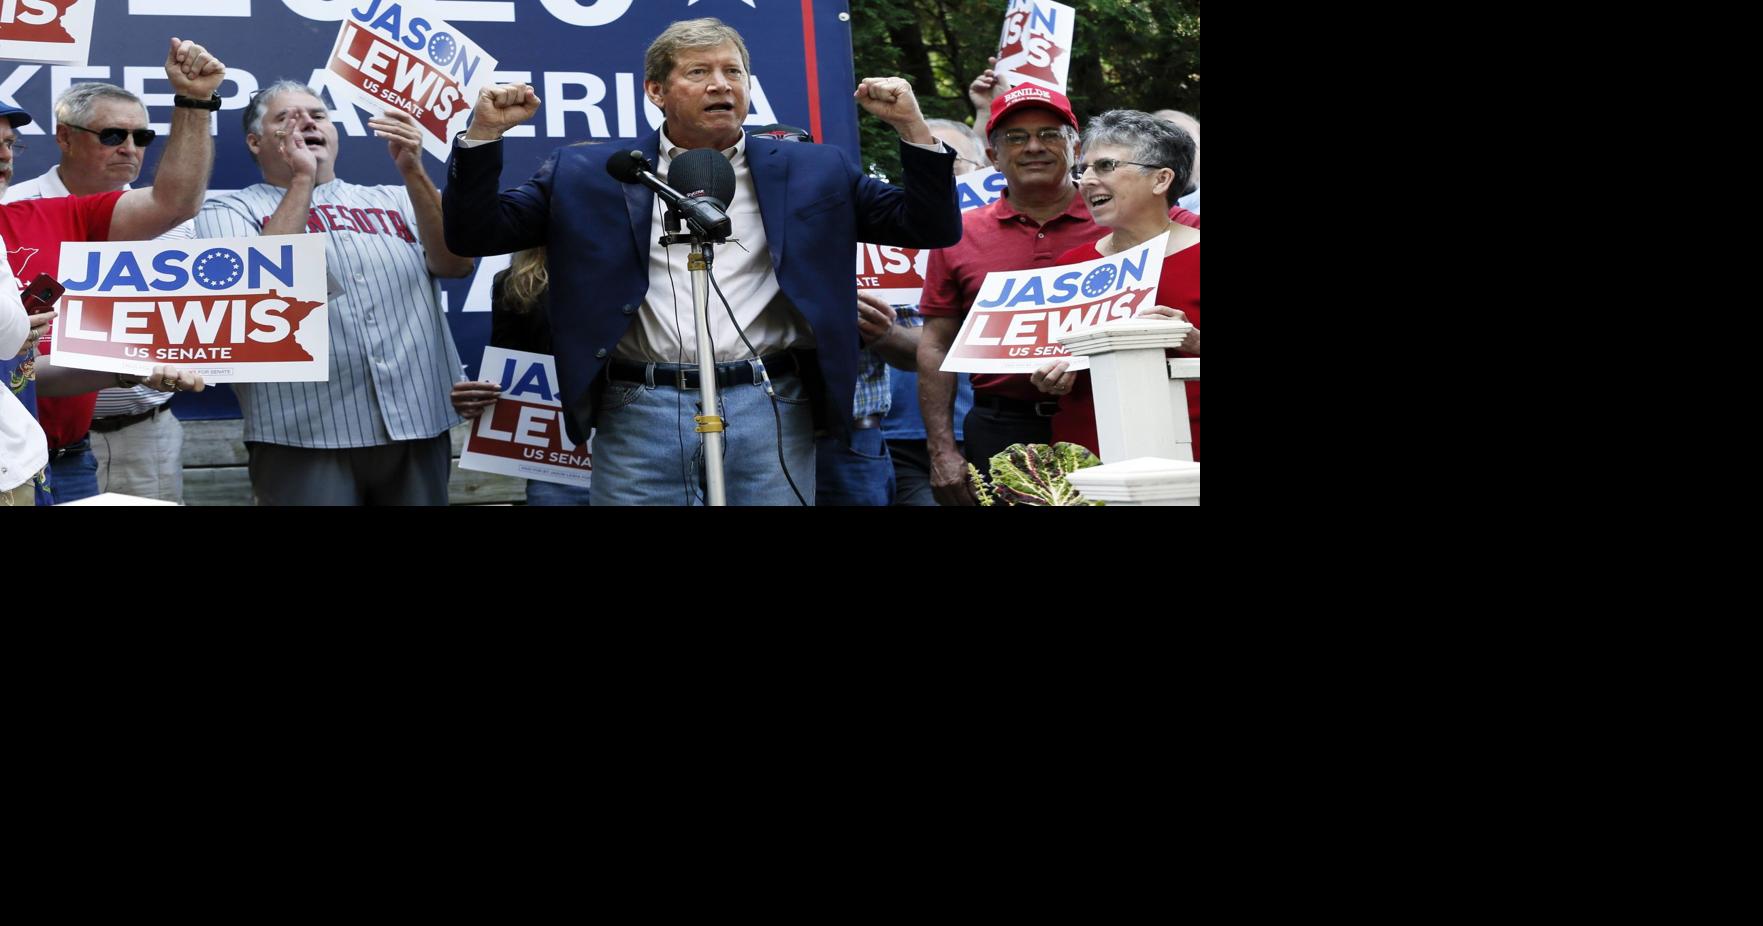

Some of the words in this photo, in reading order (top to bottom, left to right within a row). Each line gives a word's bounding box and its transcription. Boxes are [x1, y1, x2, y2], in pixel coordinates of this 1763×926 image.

[351, 0, 481, 87] JASON
[336, 24, 455, 121] LEWIS
[362, 78, 380, 94] US
[380, 88, 424, 119] SENATE
[61, 244, 295, 292] JASON
[976, 247, 1149, 308] JASON
[64, 298, 292, 345] LEWIS
[964, 292, 1138, 346] LEWIS
[124, 347, 149, 358] US
[155, 347, 232, 360] SENATE
[1008, 347, 1030, 357] US
[1033, 345, 1070, 356] SEN
[523, 447, 545, 460] US
